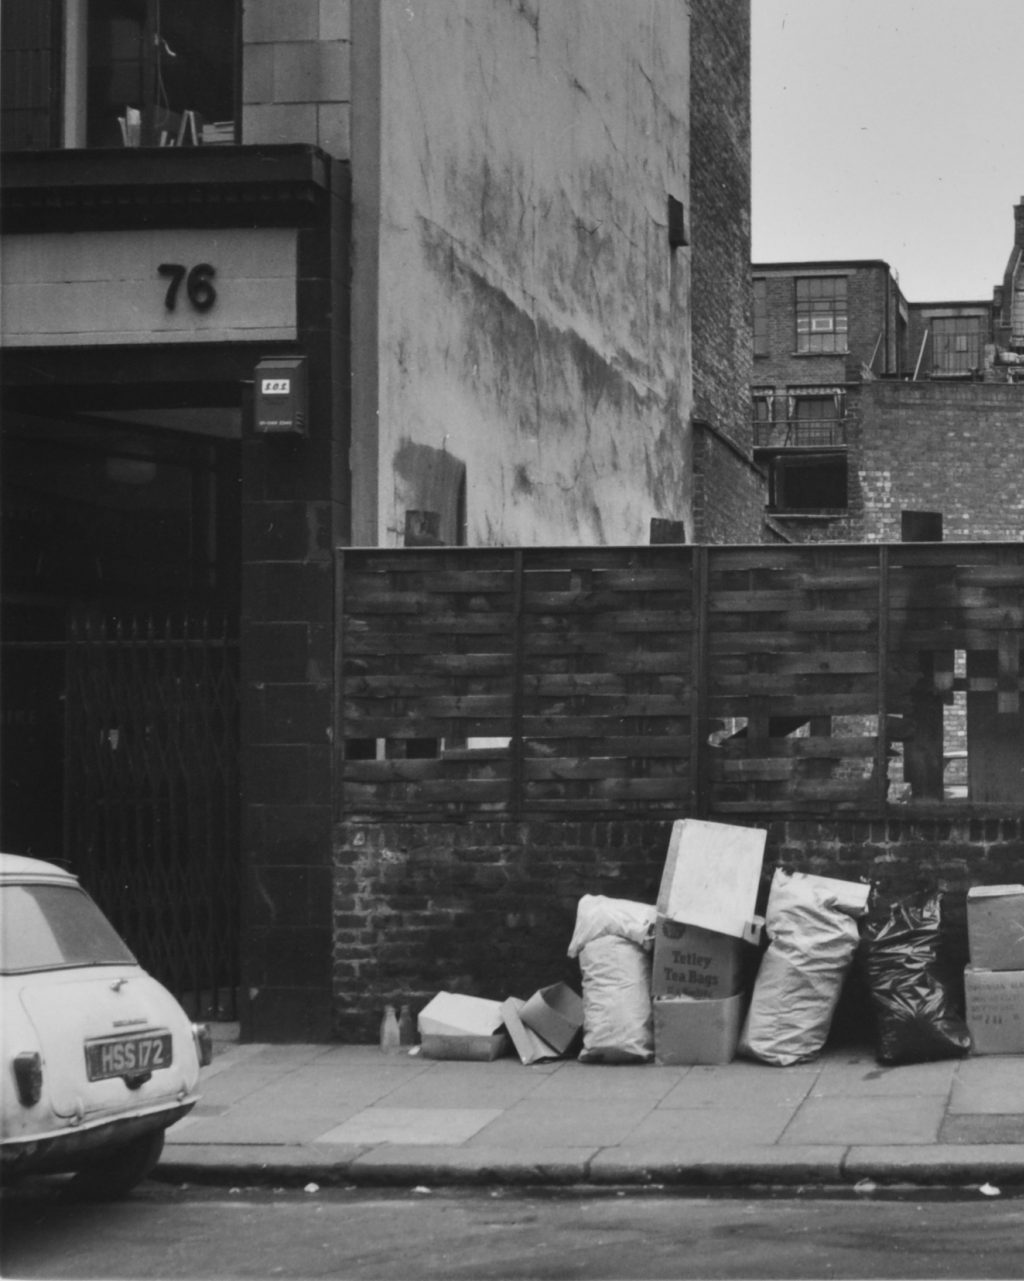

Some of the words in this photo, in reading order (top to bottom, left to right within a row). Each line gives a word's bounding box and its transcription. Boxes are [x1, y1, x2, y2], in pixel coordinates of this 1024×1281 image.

[157, 264, 217, 314] 76
[672, 950, 712, 970] Tetley
[664, 967, 686, 982] Tea
[688, 970, 719, 988] Bags
[102, 1042, 136, 1072] HSS
[138, 1039, 164, 1067] 172
